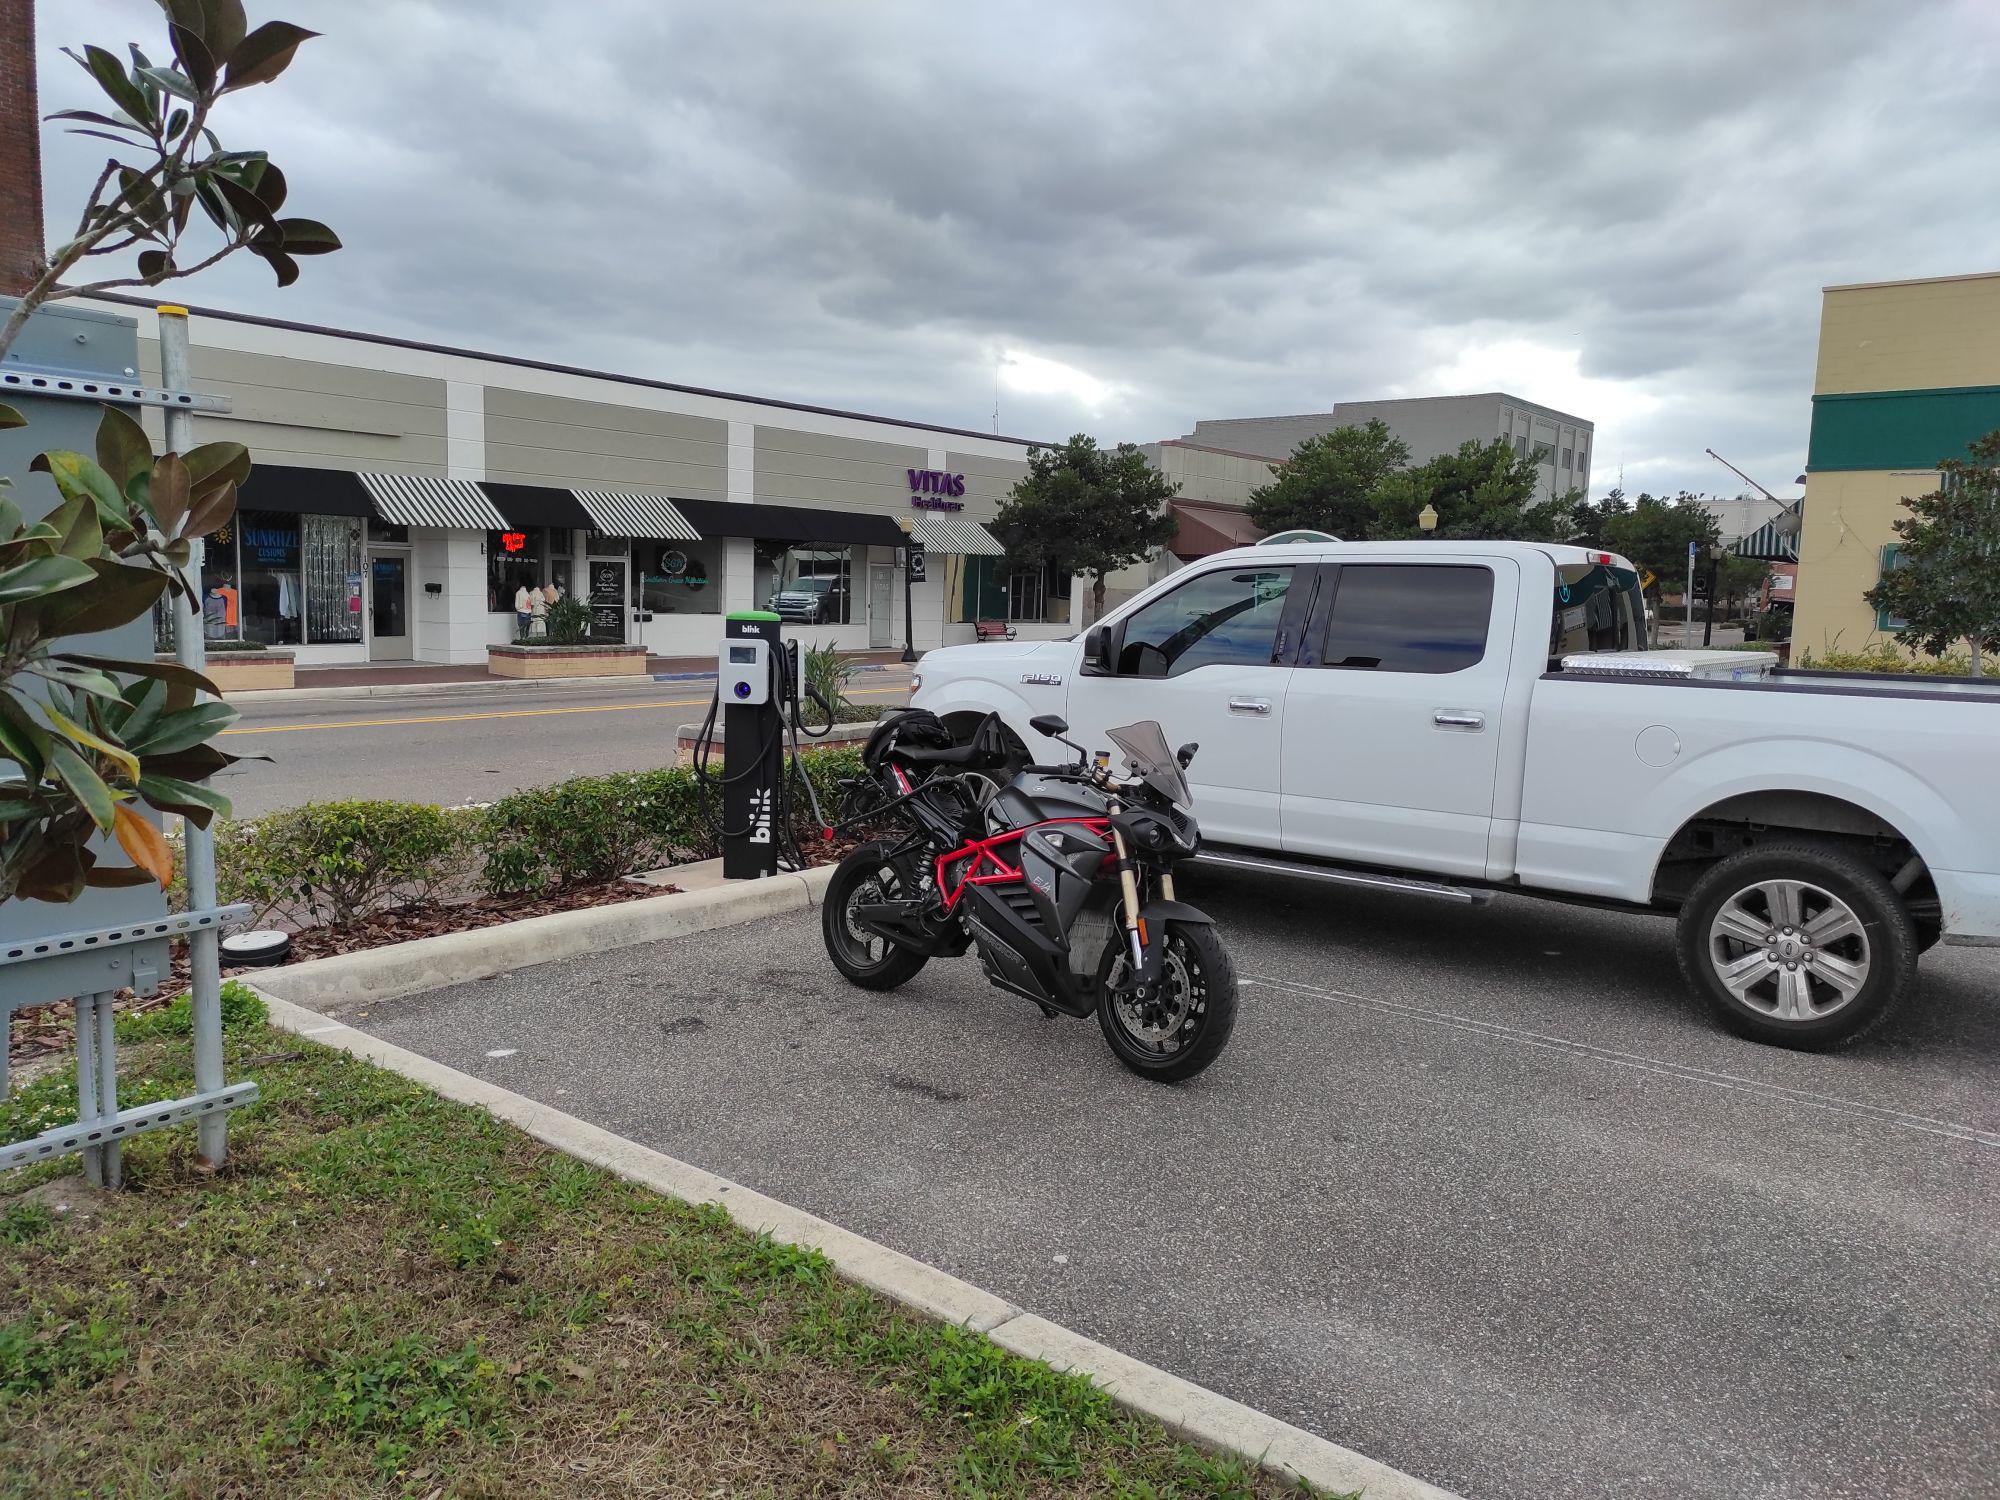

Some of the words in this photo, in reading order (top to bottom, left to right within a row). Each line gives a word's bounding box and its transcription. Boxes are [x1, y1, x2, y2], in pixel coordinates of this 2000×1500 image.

[907, 469, 965, 497] VITAS
[911, 496, 965, 512] Healthcare
[741, 624, 761, 634] blink
[749, 788, 770, 843] blink
